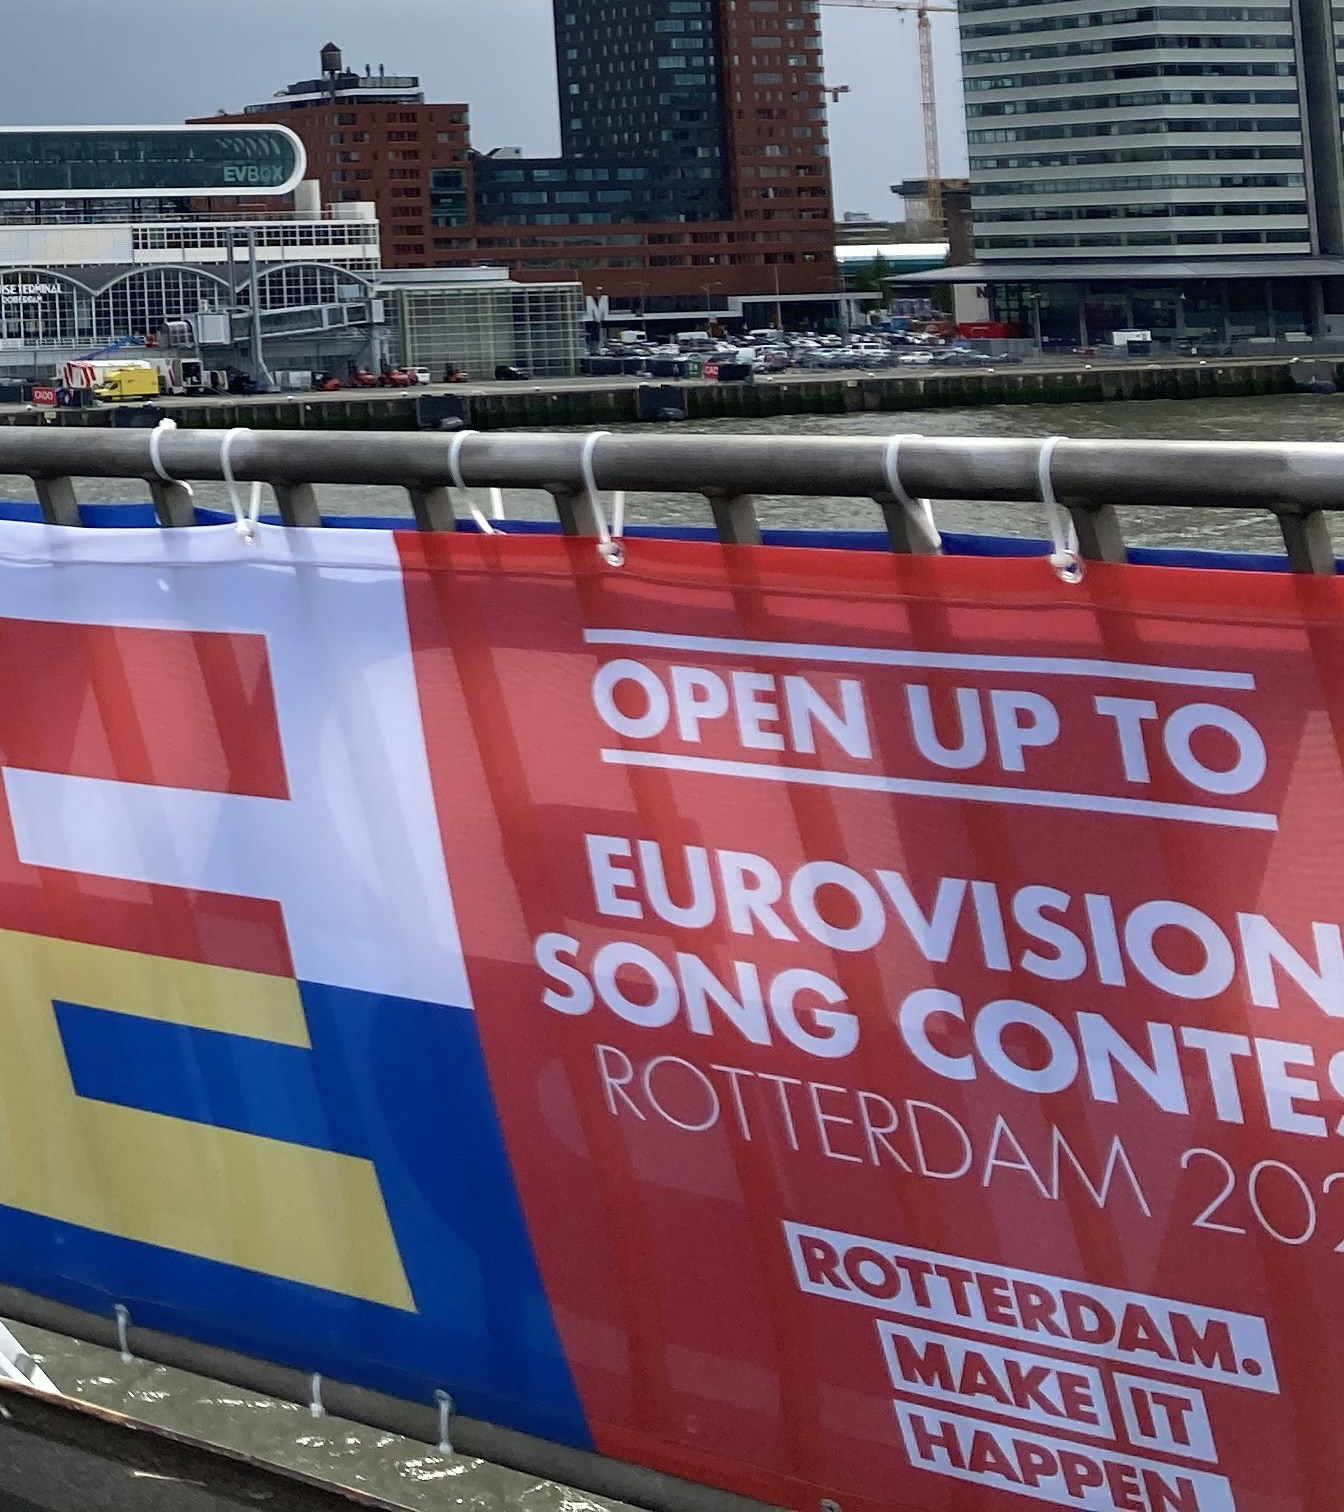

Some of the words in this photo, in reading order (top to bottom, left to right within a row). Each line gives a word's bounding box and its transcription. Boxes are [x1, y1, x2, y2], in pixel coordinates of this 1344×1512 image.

[223, 165, 284, 182] EVBOX
[18, 282, 63, 294] TERMINAL
[592, 657, 873, 760] OPEN
[904, 683, 1061, 773] UP
[1095, 695, 1269, 795] TO
[584, 832, 1344, 1018] EUROVISION
[533, 931, 860, 1060] SONG
[898, 986, 1344, 1138] CONTE
[594, 1043, 1153, 1219] ROTTERDAM
[797, 1234, 1261, 1377] ROTTERDAM.
[890, 1333, 1101, 1427] MAKE
[1132, 1387, 1193, 1447] IT
[907, 1413, 1198, 1512] HAPPEN
